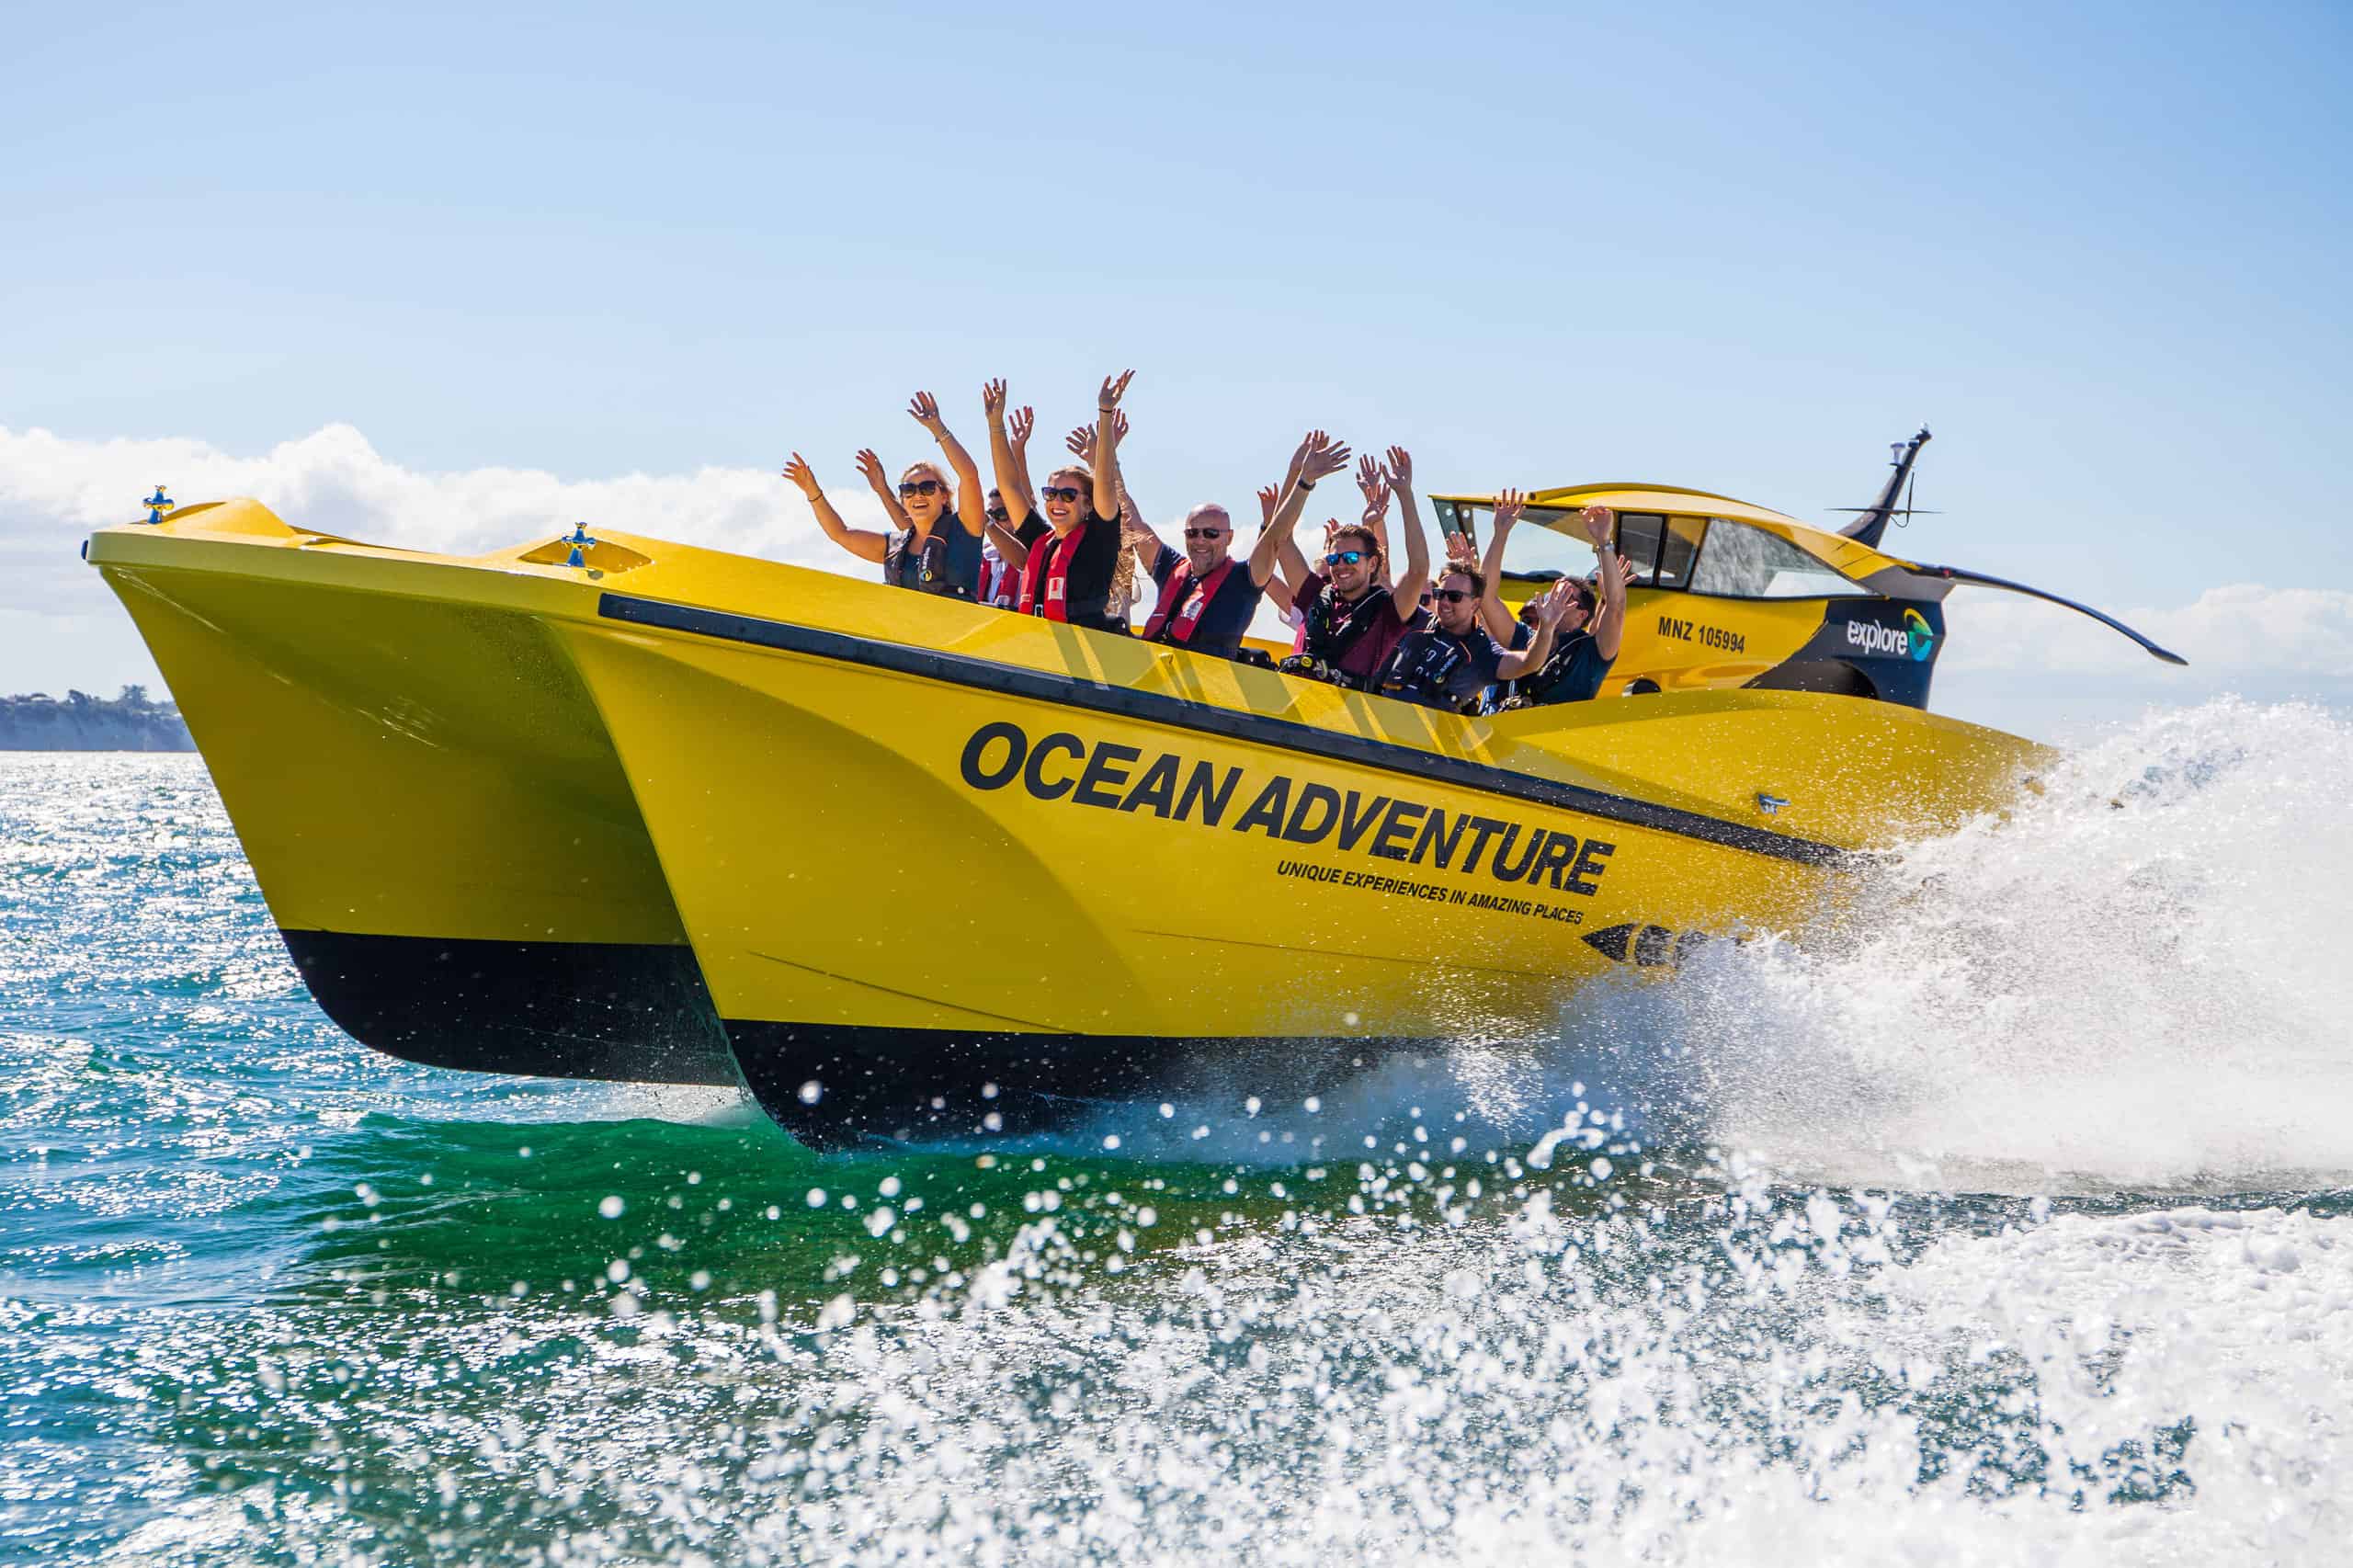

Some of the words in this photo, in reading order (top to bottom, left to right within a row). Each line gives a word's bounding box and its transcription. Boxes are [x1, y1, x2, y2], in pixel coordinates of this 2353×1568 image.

[1658, 616, 1694, 642] MNZ
[1699, 625, 1745, 654] 105994
[1847, 619, 1908, 654] explore
[961, 722, 1244, 827] OCEAN
[1233, 775, 1616, 897] ADVENTURE
[1277, 859, 1342, 883] UNIQUE
[1342, 871, 1448, 902] EXPERIENCES
[1449, 889, 1468, 905] IN
[1468, 892, 1533, 917] AMAZING
[1533, 903, 1584, 925] PLACES
